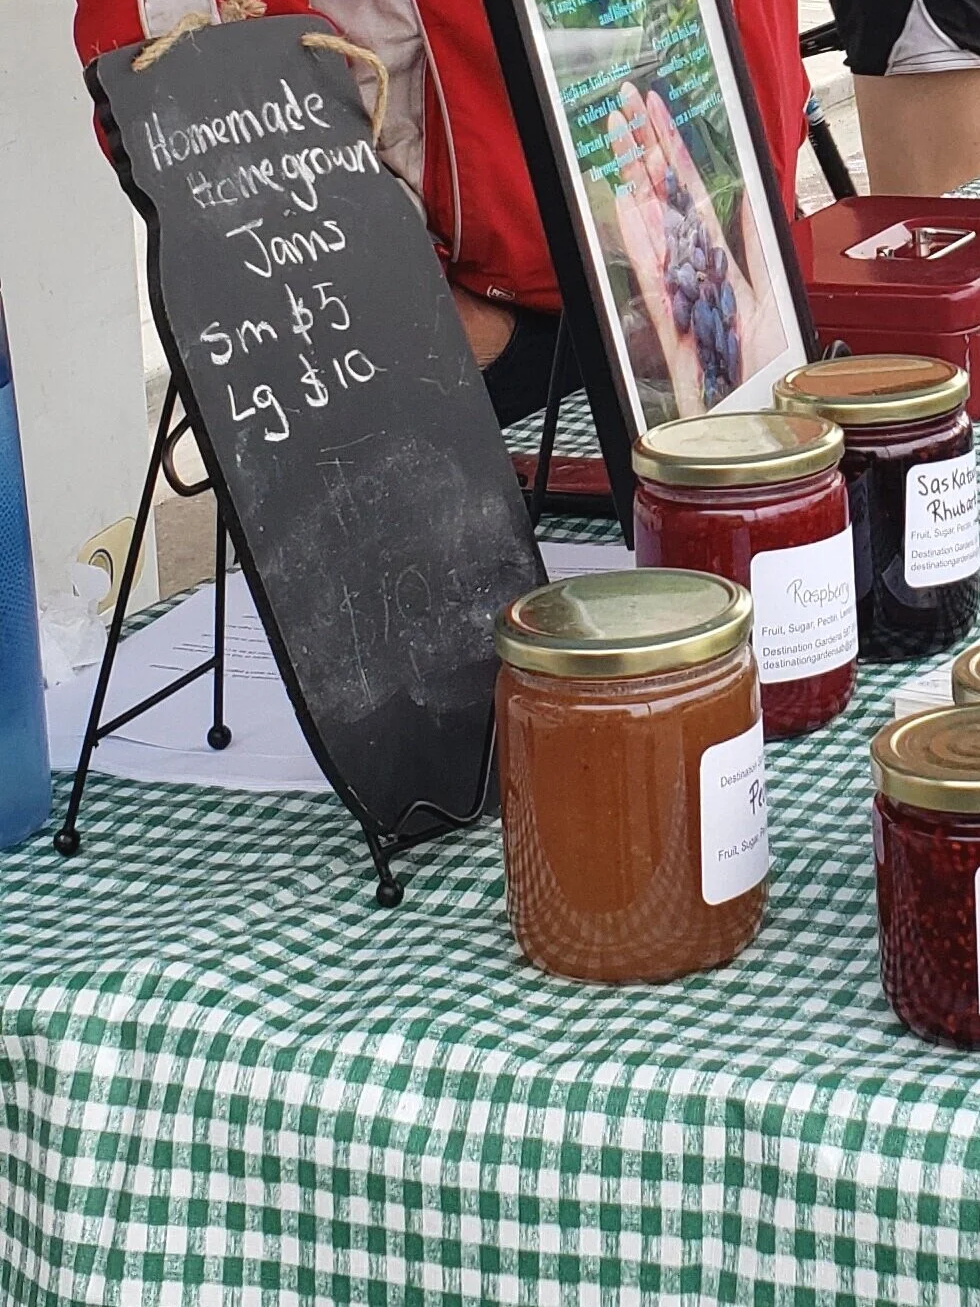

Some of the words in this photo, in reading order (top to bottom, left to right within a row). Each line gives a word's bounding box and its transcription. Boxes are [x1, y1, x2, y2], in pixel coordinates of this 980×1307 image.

[145, 78, 332, 172] Homemade
[226, 218, 346, 278] Jams
[227, 384, 290, 442] Lg
[299, 349, 379, 407] $10
[911, 531, 932, 540] Fruit,
[912, 546, 953, 559] Destination
[762, 625, 786, 637] Fruit,
[788, 620, 815, 635] Sugar,
[763, 642, 813, 657] Destination
